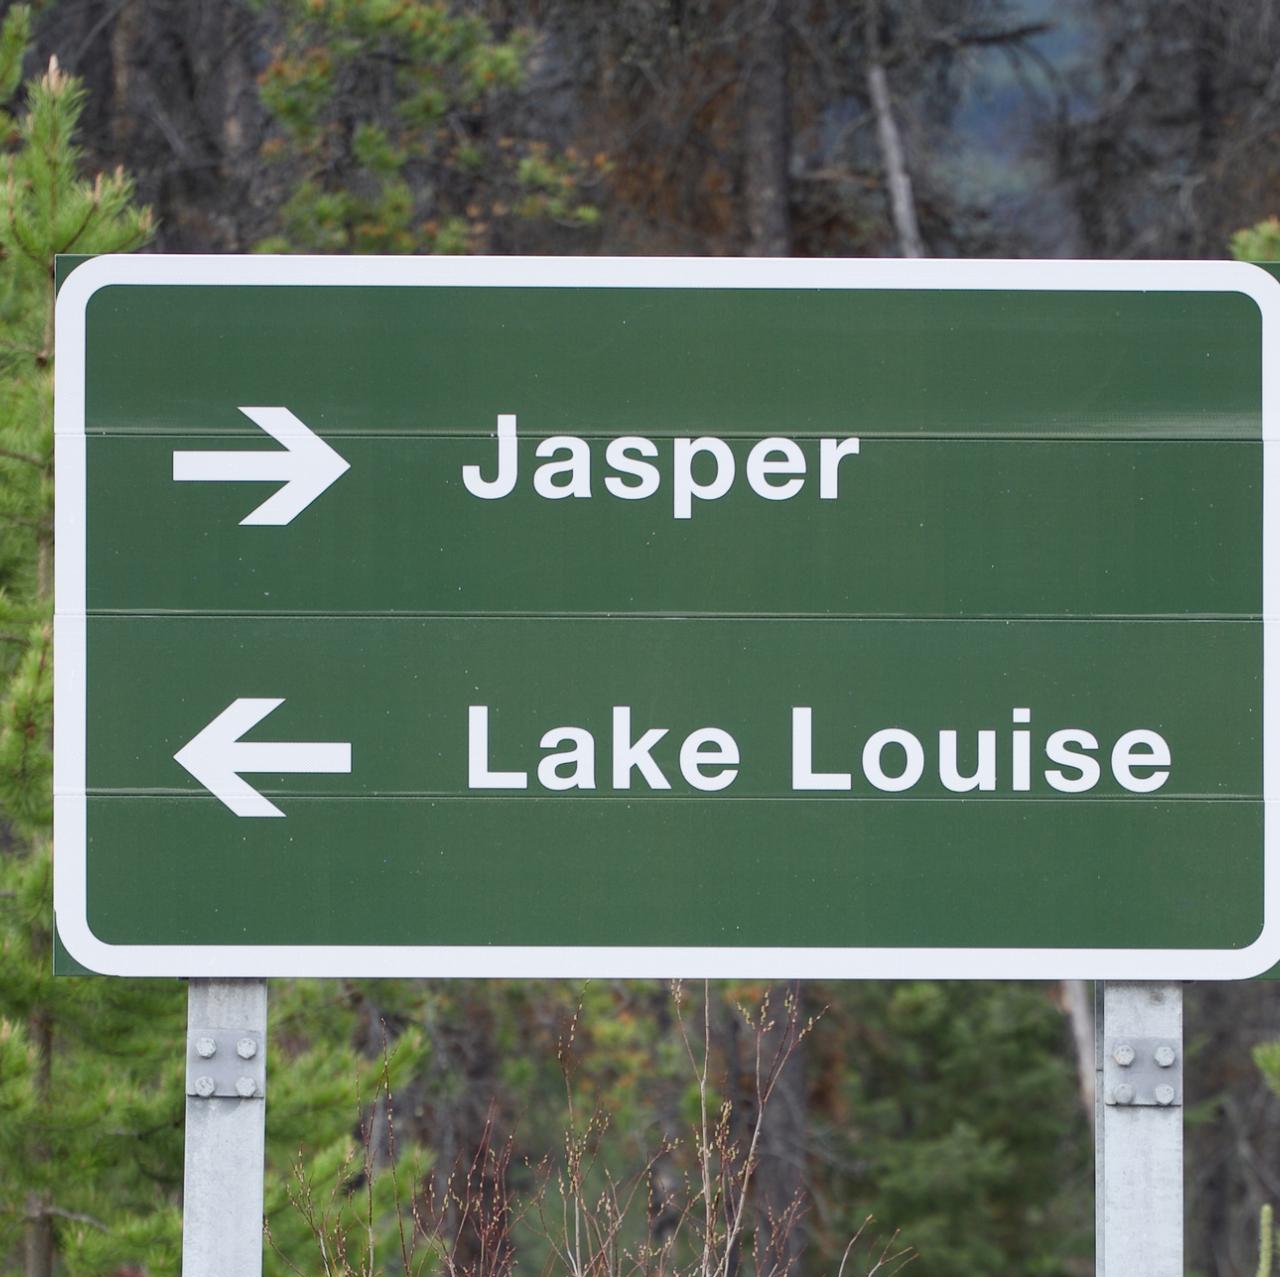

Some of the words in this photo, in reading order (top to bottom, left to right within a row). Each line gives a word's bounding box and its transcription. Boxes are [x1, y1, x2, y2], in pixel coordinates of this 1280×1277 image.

[462, 414, 861, 519] Jasper
[468, 705, 740, 793] Lake
[792, 706, 1172, 793] Louise
